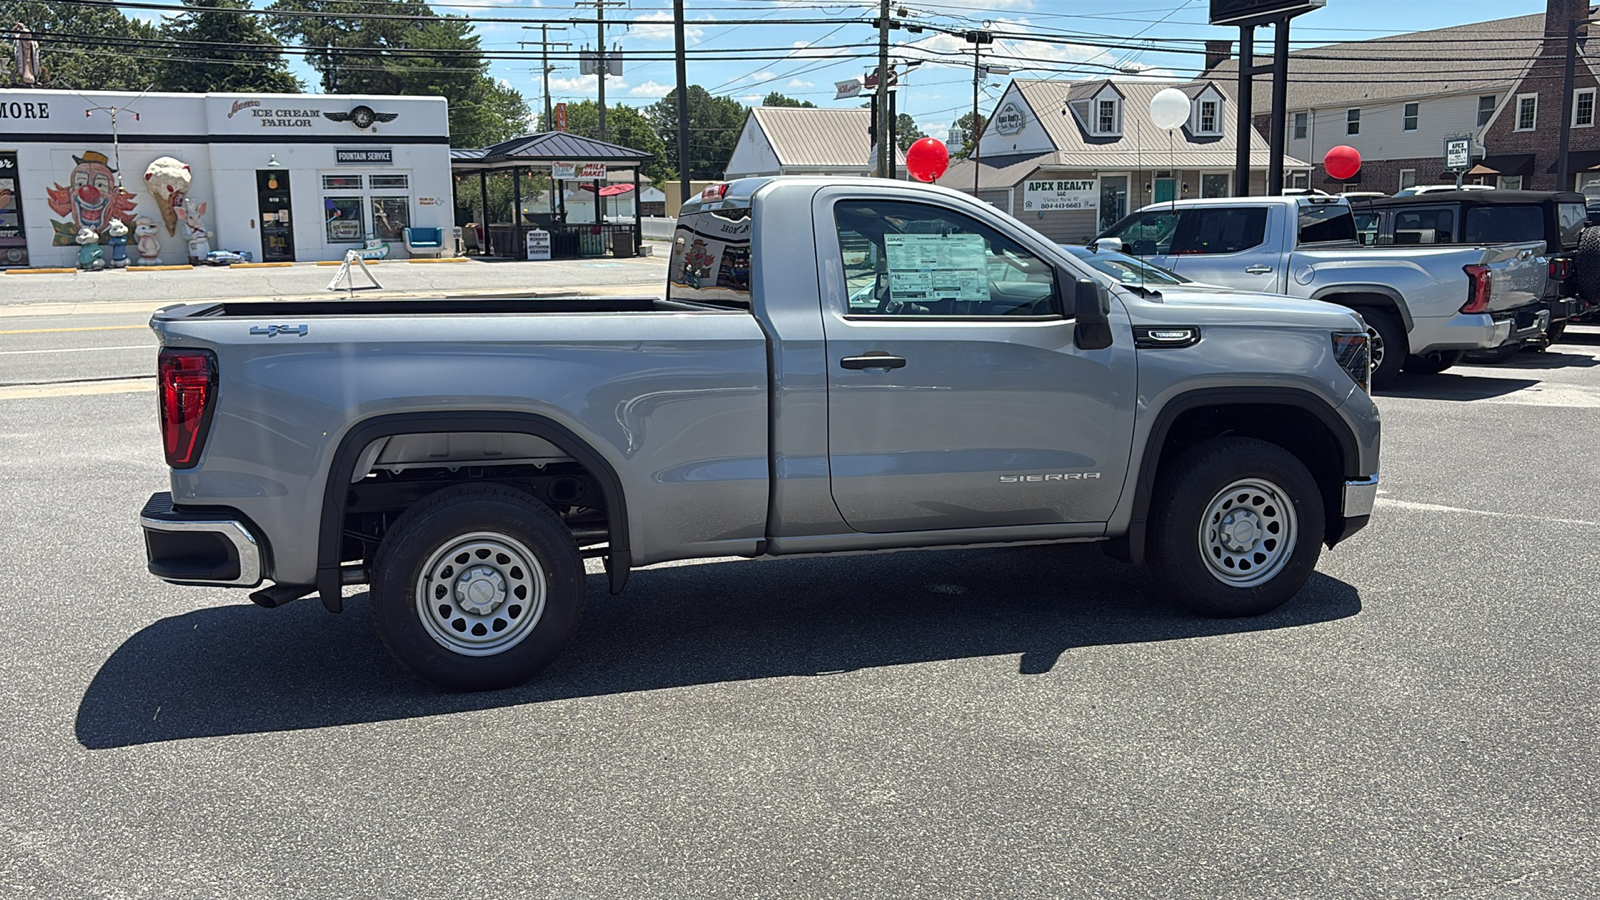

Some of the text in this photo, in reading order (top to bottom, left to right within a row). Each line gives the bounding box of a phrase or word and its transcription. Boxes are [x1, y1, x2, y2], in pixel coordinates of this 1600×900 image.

[252, 109, 321, 118] ICE CREAM
[261, 119, 312, 127] PARLOR
[338, 152, 391, 160] FOUNTAIN SERVICE
[580, 170, 605, 178] SHAKES
[1028, 181, 1094, 191] APEX REALTY
[1000, 472, 1101, 483] SIERRA
